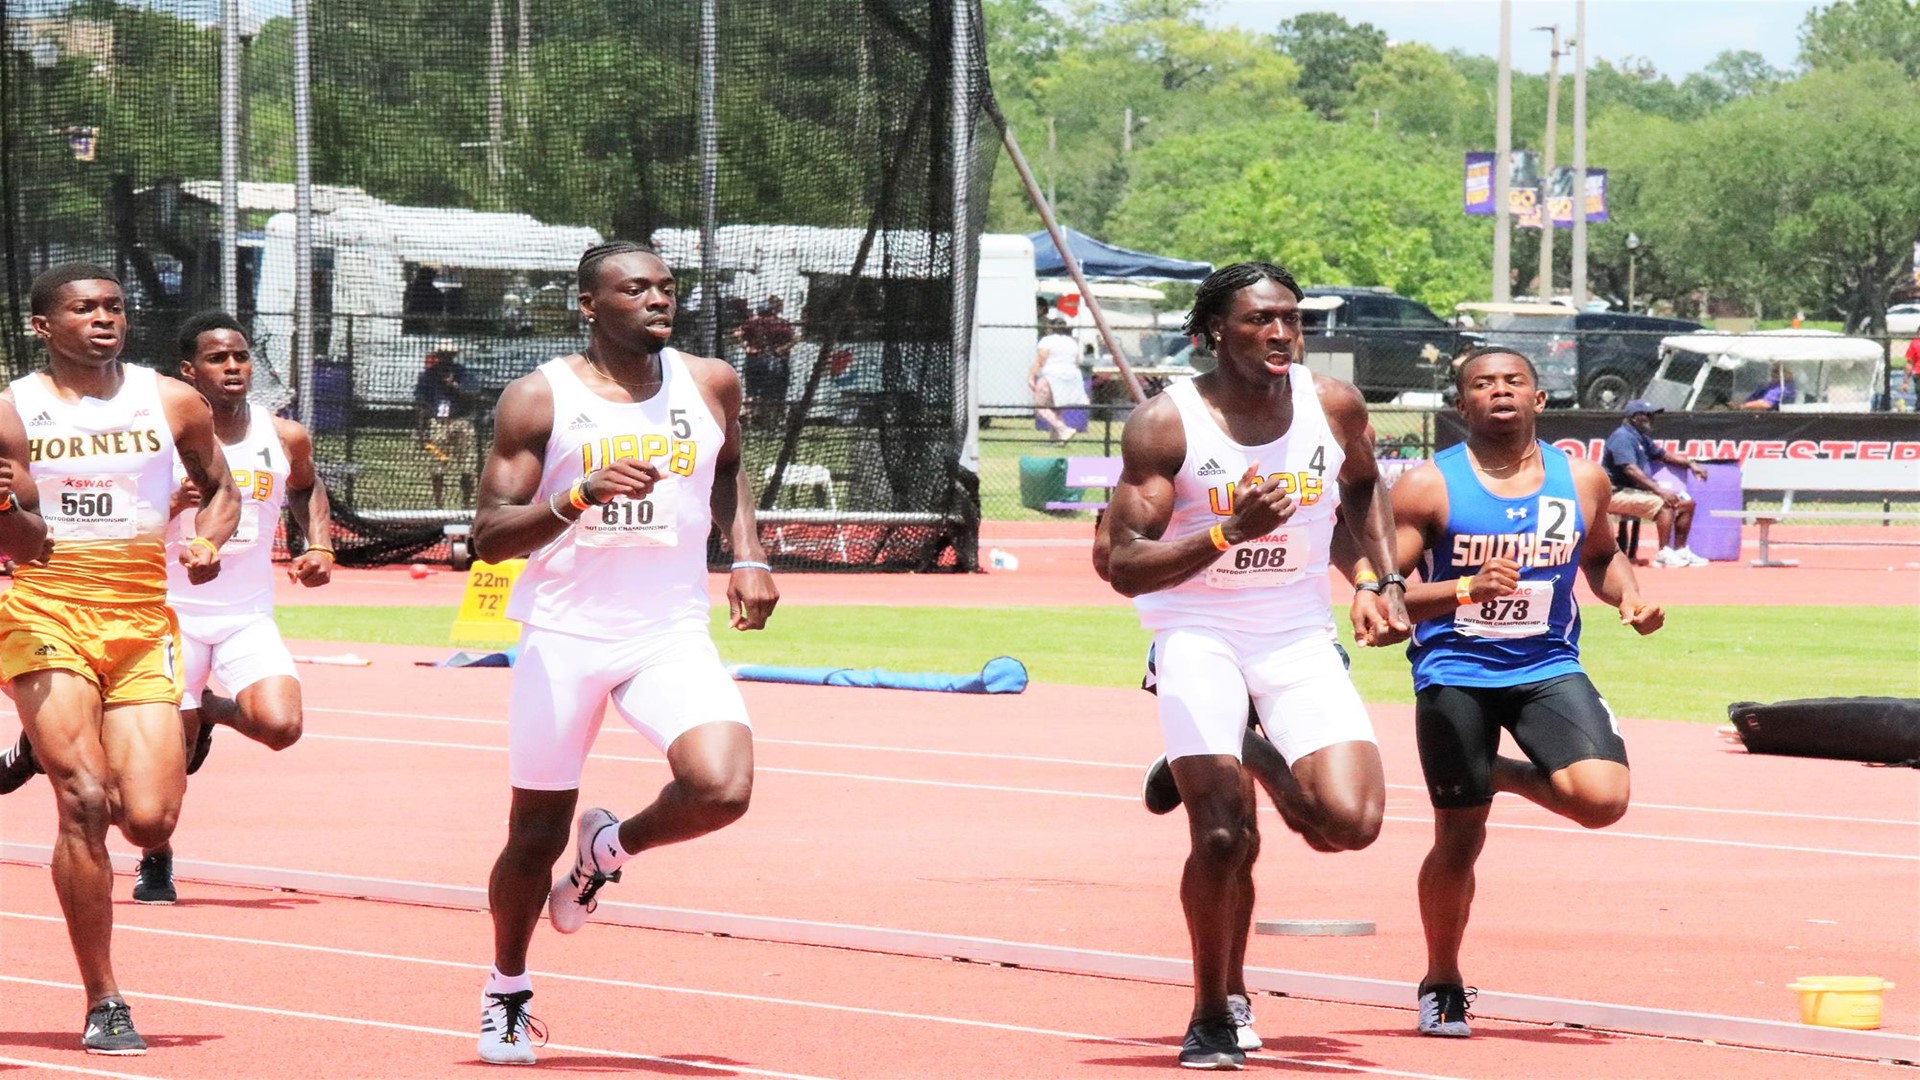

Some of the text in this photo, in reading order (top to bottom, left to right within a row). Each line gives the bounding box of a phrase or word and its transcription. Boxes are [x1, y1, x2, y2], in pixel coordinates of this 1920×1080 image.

[568, 422, 598, 431] adidas
[669, 409, 691, 439] 5
[28, 429, 161, 462] HORNETS
[582, 433, 697, 478] UAPB
[257, 447, 272, 469] 1
[1308, 445, 1326, 477] 4
[75, 479, 113, 488] SWAC
[1197, 468, 1227, 477] adidas
[61, 492, 113, 517] 550
[602, 500, 654, 525] 610
[44, 515, 76, 523] OUTDOOR
[618, 524, 669, 532] CHAMPIONSHIP
[1544, 500, 1567, 541] 2
[1234, 547, 1287, 570] 608
[1451, 531, 1581, 567] SOUTHERN
[473, 572, 509, 588] 22m
[1216, 567, 1248, 575] OUTDOOR
[1480, 599, 1530, 621] 873
[1463, 617, 1493, 626] OUTDOOR
